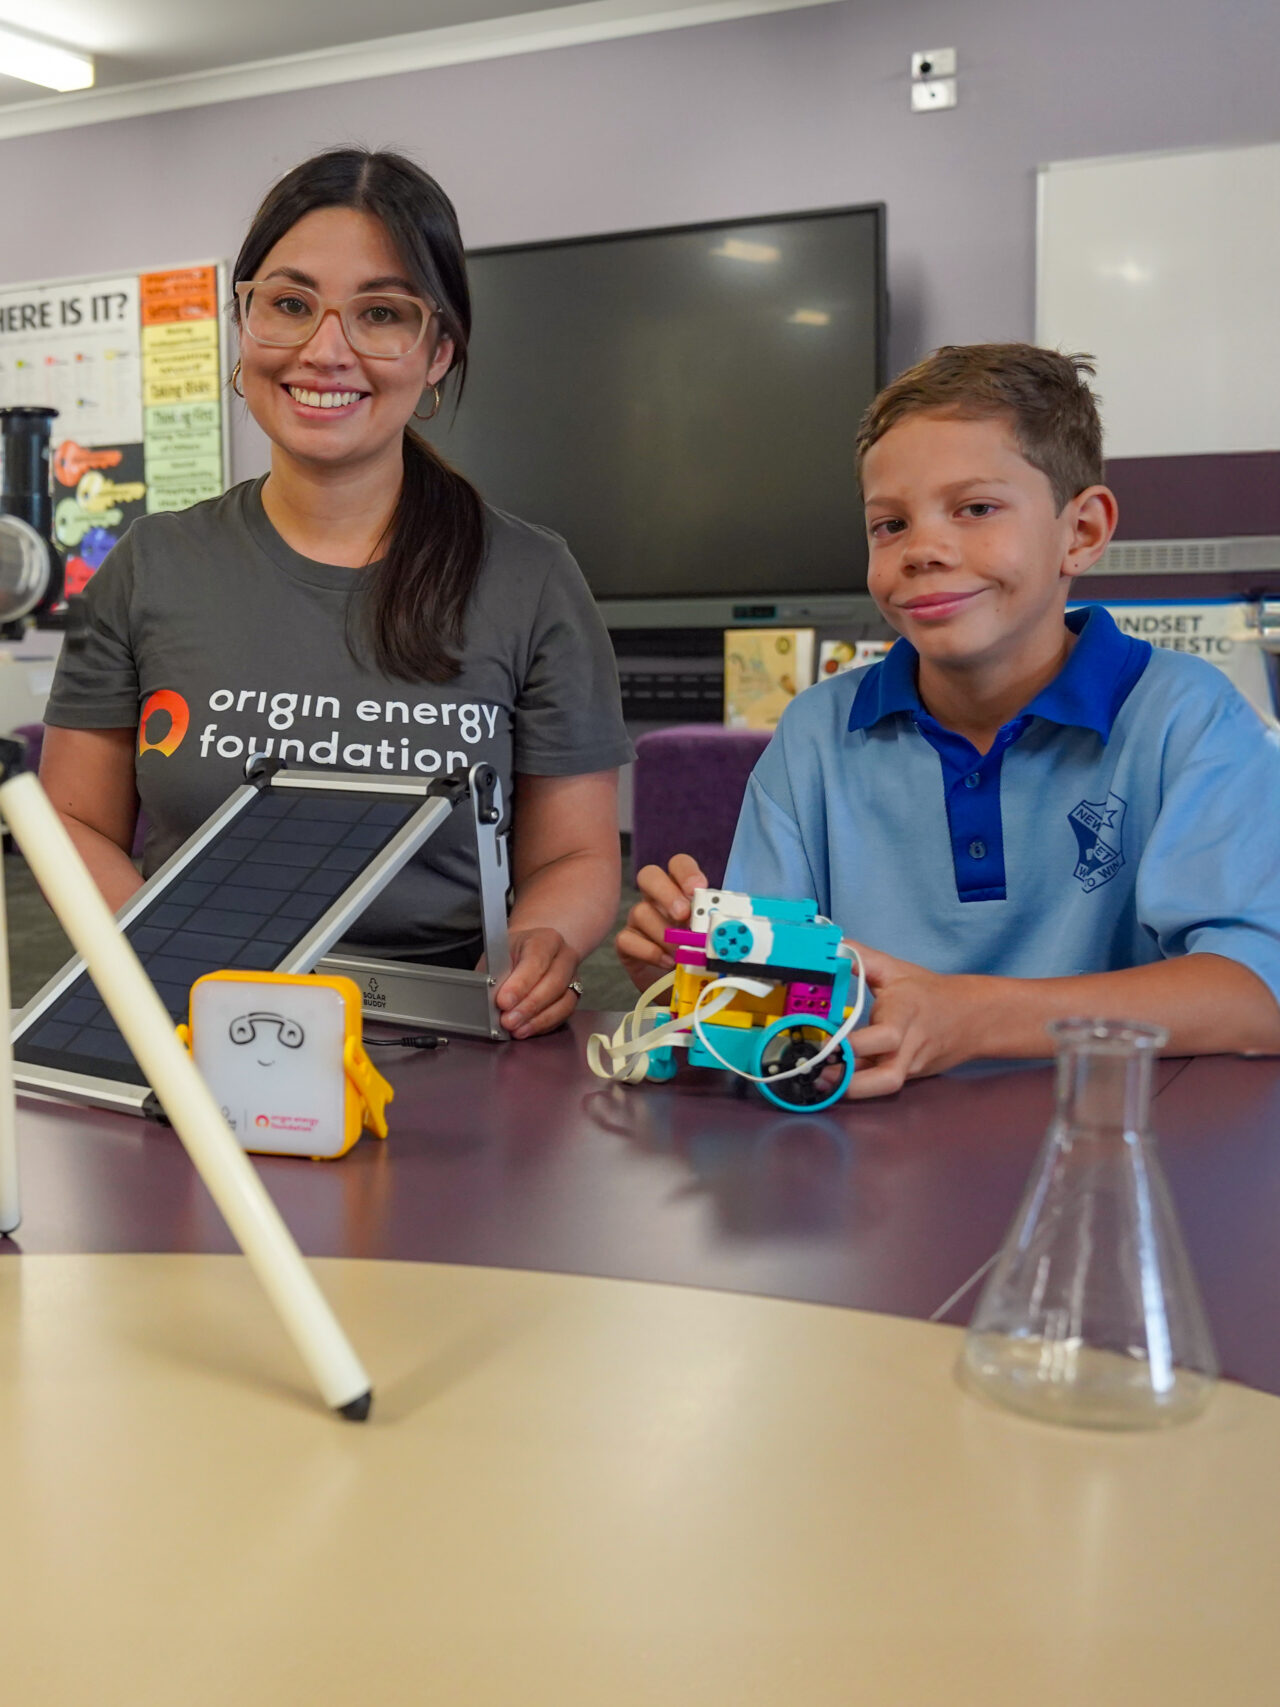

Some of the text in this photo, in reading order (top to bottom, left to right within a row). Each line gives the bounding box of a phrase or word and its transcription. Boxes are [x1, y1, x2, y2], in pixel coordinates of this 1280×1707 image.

[61, 298, 82, 326] IS
[91, 293, 128, 322] IT?
[1116, 614, 1202, 634] INDSET
[209, 689, 499, 744] origin energy
[200, 724, 468, 774] foundation
[363, 992, 386, 1002] SOLAR
[363, 999, 386, 1008] BUDDY
